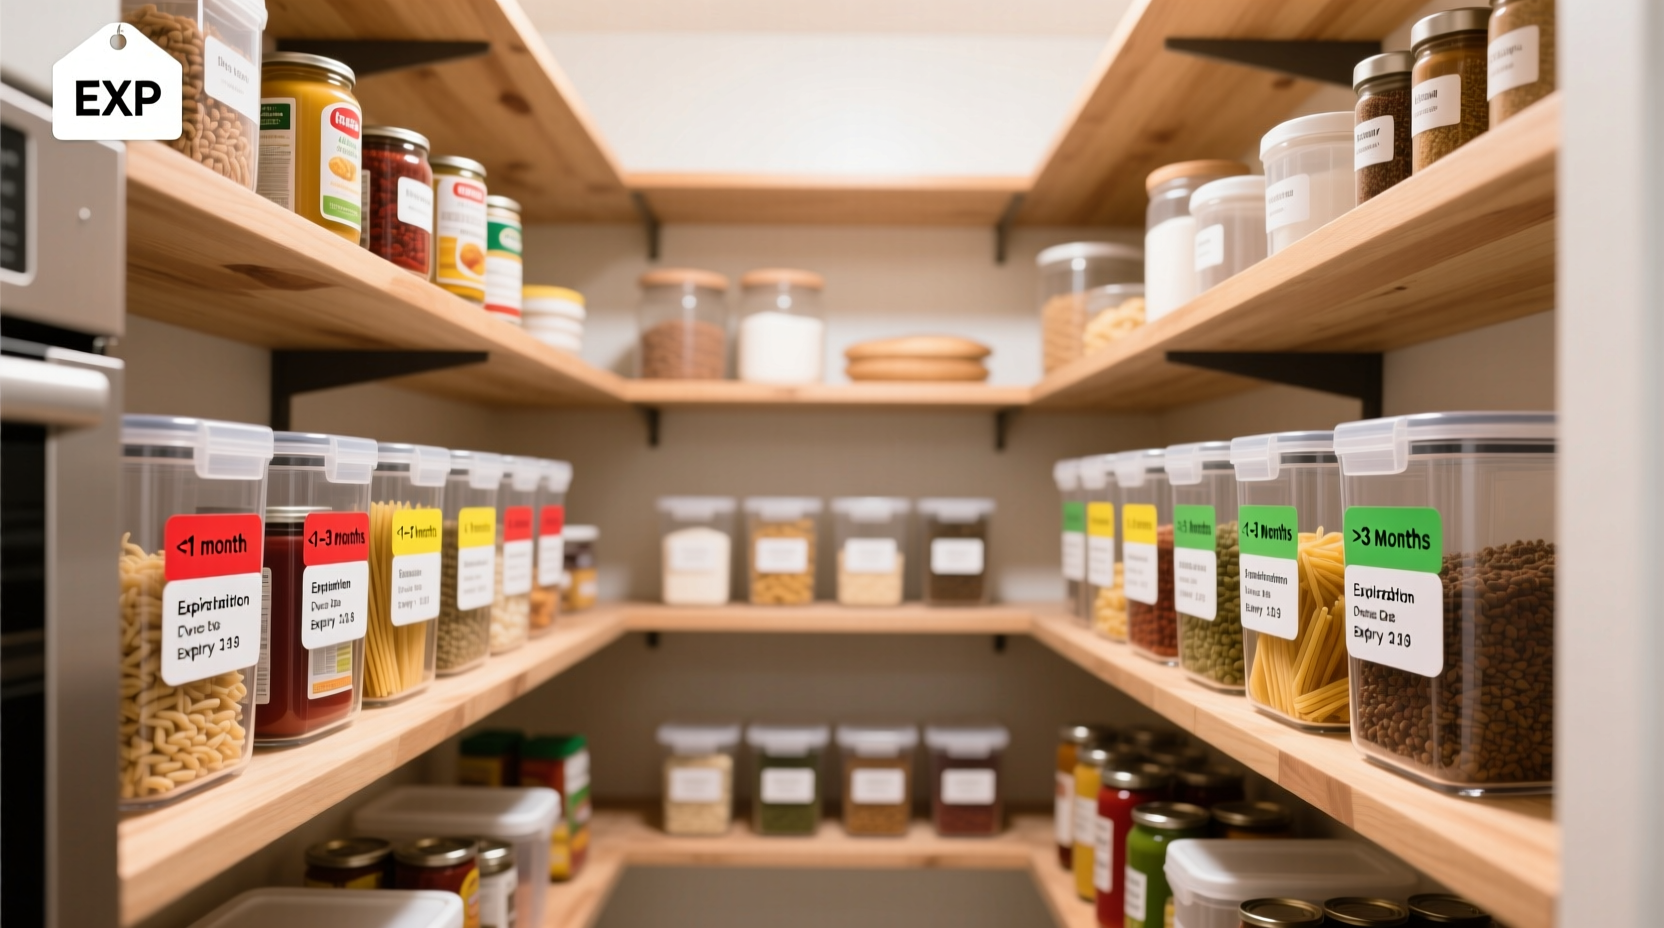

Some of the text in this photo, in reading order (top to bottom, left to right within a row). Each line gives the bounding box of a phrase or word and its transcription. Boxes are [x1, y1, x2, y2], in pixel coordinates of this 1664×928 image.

[176, 533, 247, 557] <1 month
[1352, 526, 1431, 550] >3 Months
